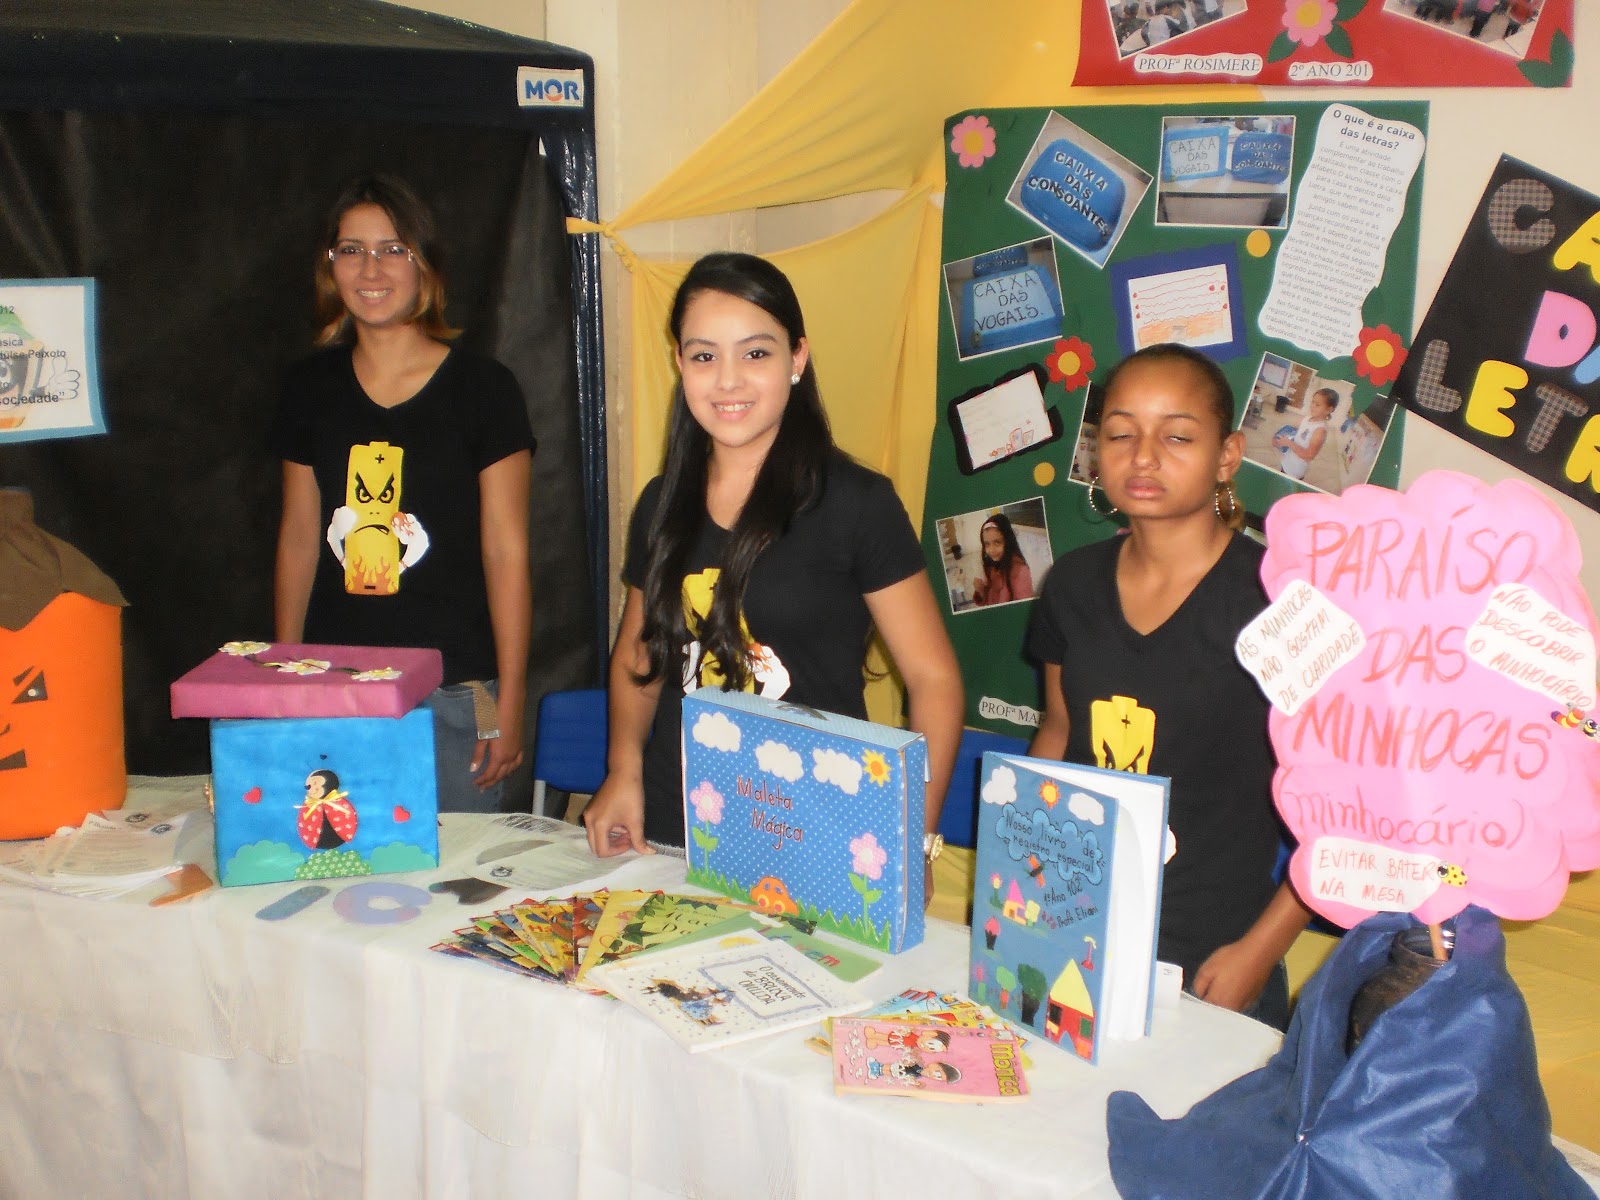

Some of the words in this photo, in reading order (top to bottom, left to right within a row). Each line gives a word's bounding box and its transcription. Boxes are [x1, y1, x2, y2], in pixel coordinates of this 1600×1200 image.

[1184, 58, 1260, 71] ROSIMERE
[1306, 64, 1341, 77] ANO
[525, 79, 579, 102] MOR
[1333, 109, 1341, 118] O
[1344, 114, 1364, 126] que
[1367, 118, 1374, 128] é
[1377, 123, 1384, 131] a
[1387, 126, 1415, 140] caixa
[1170, 138, 1216, 154] CAIXA
[1340, 127, 1359, 138] das
[1362, 132, 1399, 150] letras?
[1172, 163, 1210, 175] VOGAIS
[1187, 151, 1208, 161] DAS
[1054, 151, 1108, 191] CAIXA
[1064, 173, 1093, 200] DAS
[974, 272, 1037, 298] CAIXA
[998, 291, 1028, 307] DAS
[28, 349, 66, 359] Peixoto
[1305, 504, 1538, 599] PARAÍSO
[1238, 637, 1259, 661] AS
[1260, 585, 1312, 640] MINHOCAS
[1539, 611, 1586, 638] PODE
[1260, 655, 1283, 682] NÃO
[1287, 608, 1330, 658] GOSTAM
[1470, 639, 1486, 654] O
[1478, 609, 1585, 665] DESCOBRIR
[1279, 684, 1298, 710] DE
[1302, 622, 1360, 688] CLARIDADE
[1362, 624, 1467, 686] DAS
[1018, 709, 1041, 725] MA
[1293, 692, 1552, 780] MINHOCAS
[736, 774, 793, 811] Maleta
[751, 807, 803, 850] Mágica
[1005, 812, 1033, 836] Nosso
[1041, 823, 1067, 850] livro
[1083, 841, 1095, 859] de
[1013, 835, 1050, 856] registro
[1057, 853, 1095, 874] especial
[1320, 849, 1377, 870] EVITAR
[1386, 858, 1438, 881] BATER
[1320, 879, 1345, 898] NA
[1362, 885, 1405, 905] MESA
